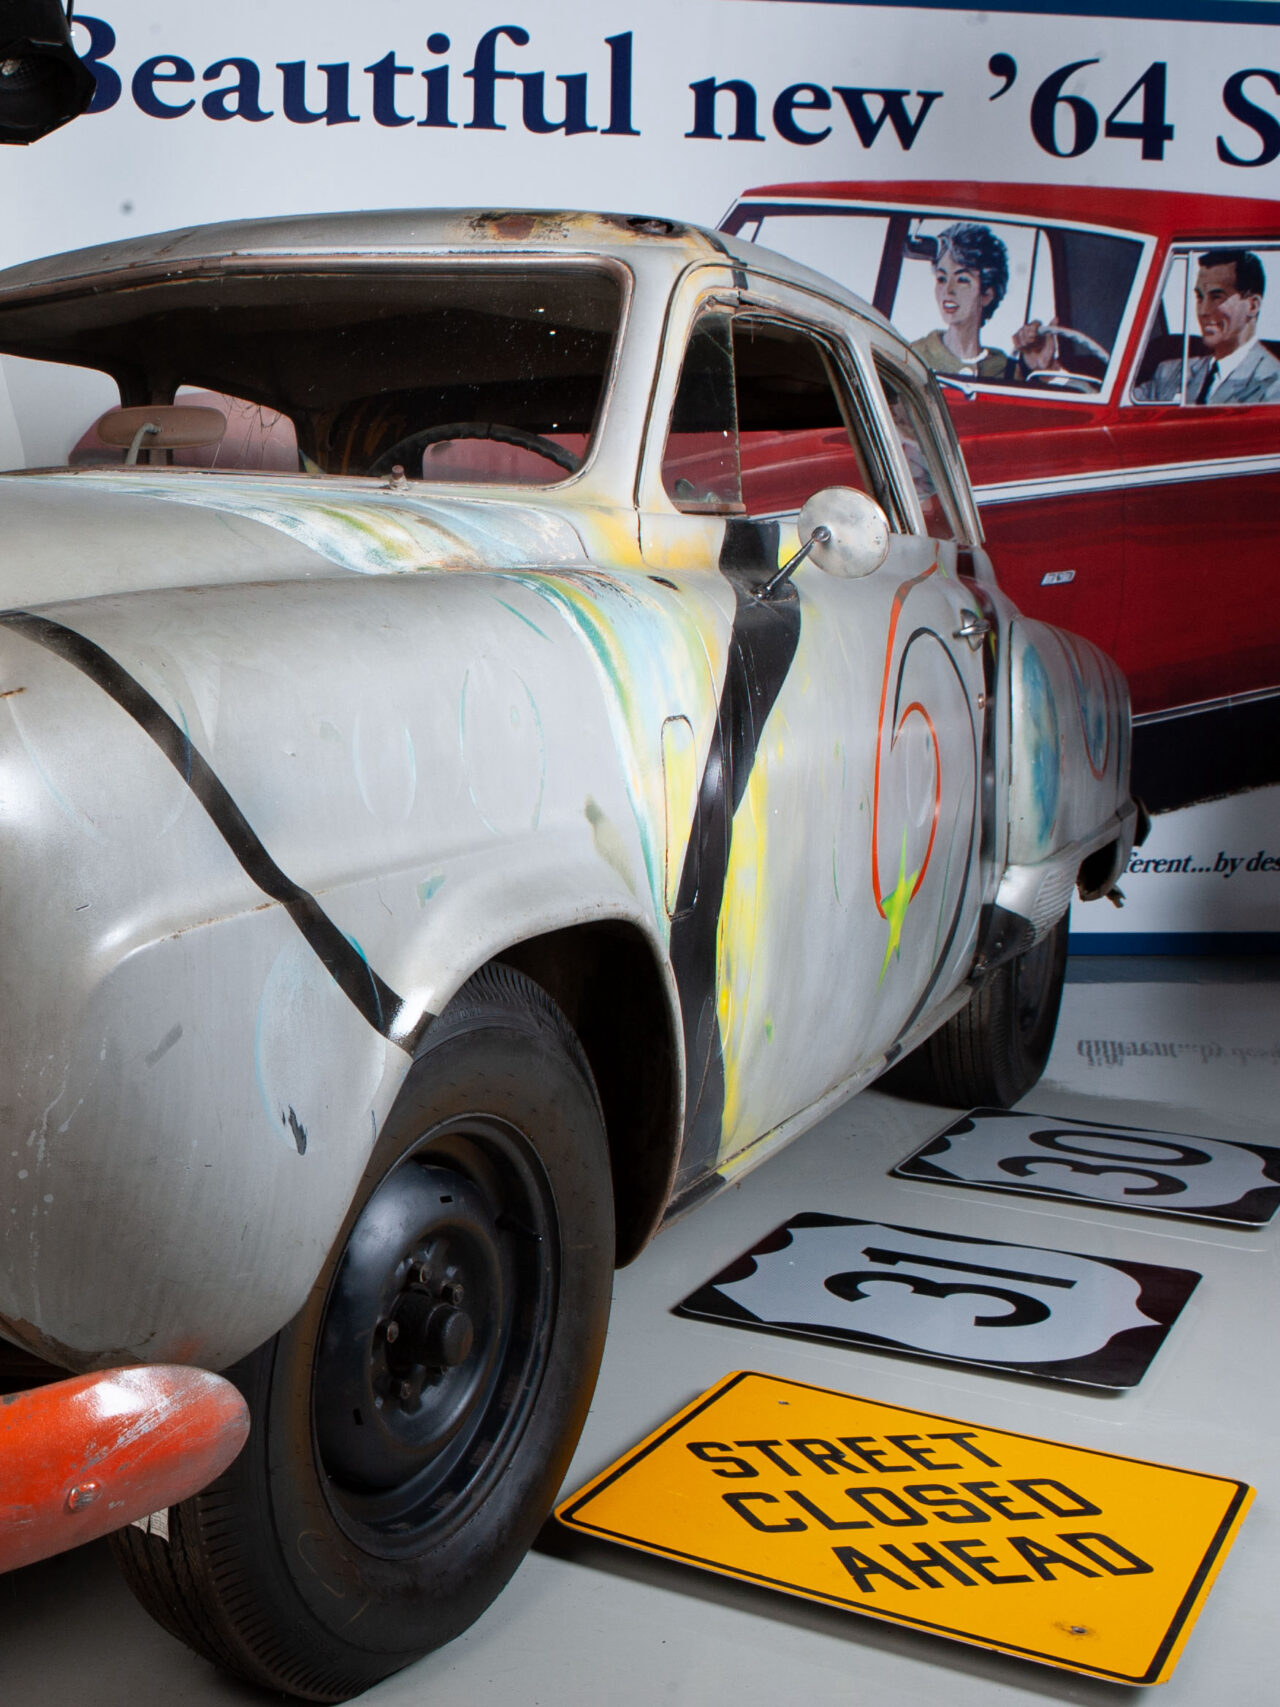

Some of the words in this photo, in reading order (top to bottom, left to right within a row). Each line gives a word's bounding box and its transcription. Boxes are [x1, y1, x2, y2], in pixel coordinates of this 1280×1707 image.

[684, 76, 944, 151] new
[987, 52, 1175, 160] '64
[997, 1129, 1213, 1196] 30
[823, 1246, 1078, 1328] 31
[686, 1432, 1003, 1479] STREET
[721, 1478, 1103, 1533] CLOSED
[831, 1532, 1154, 1593] AHEAD
